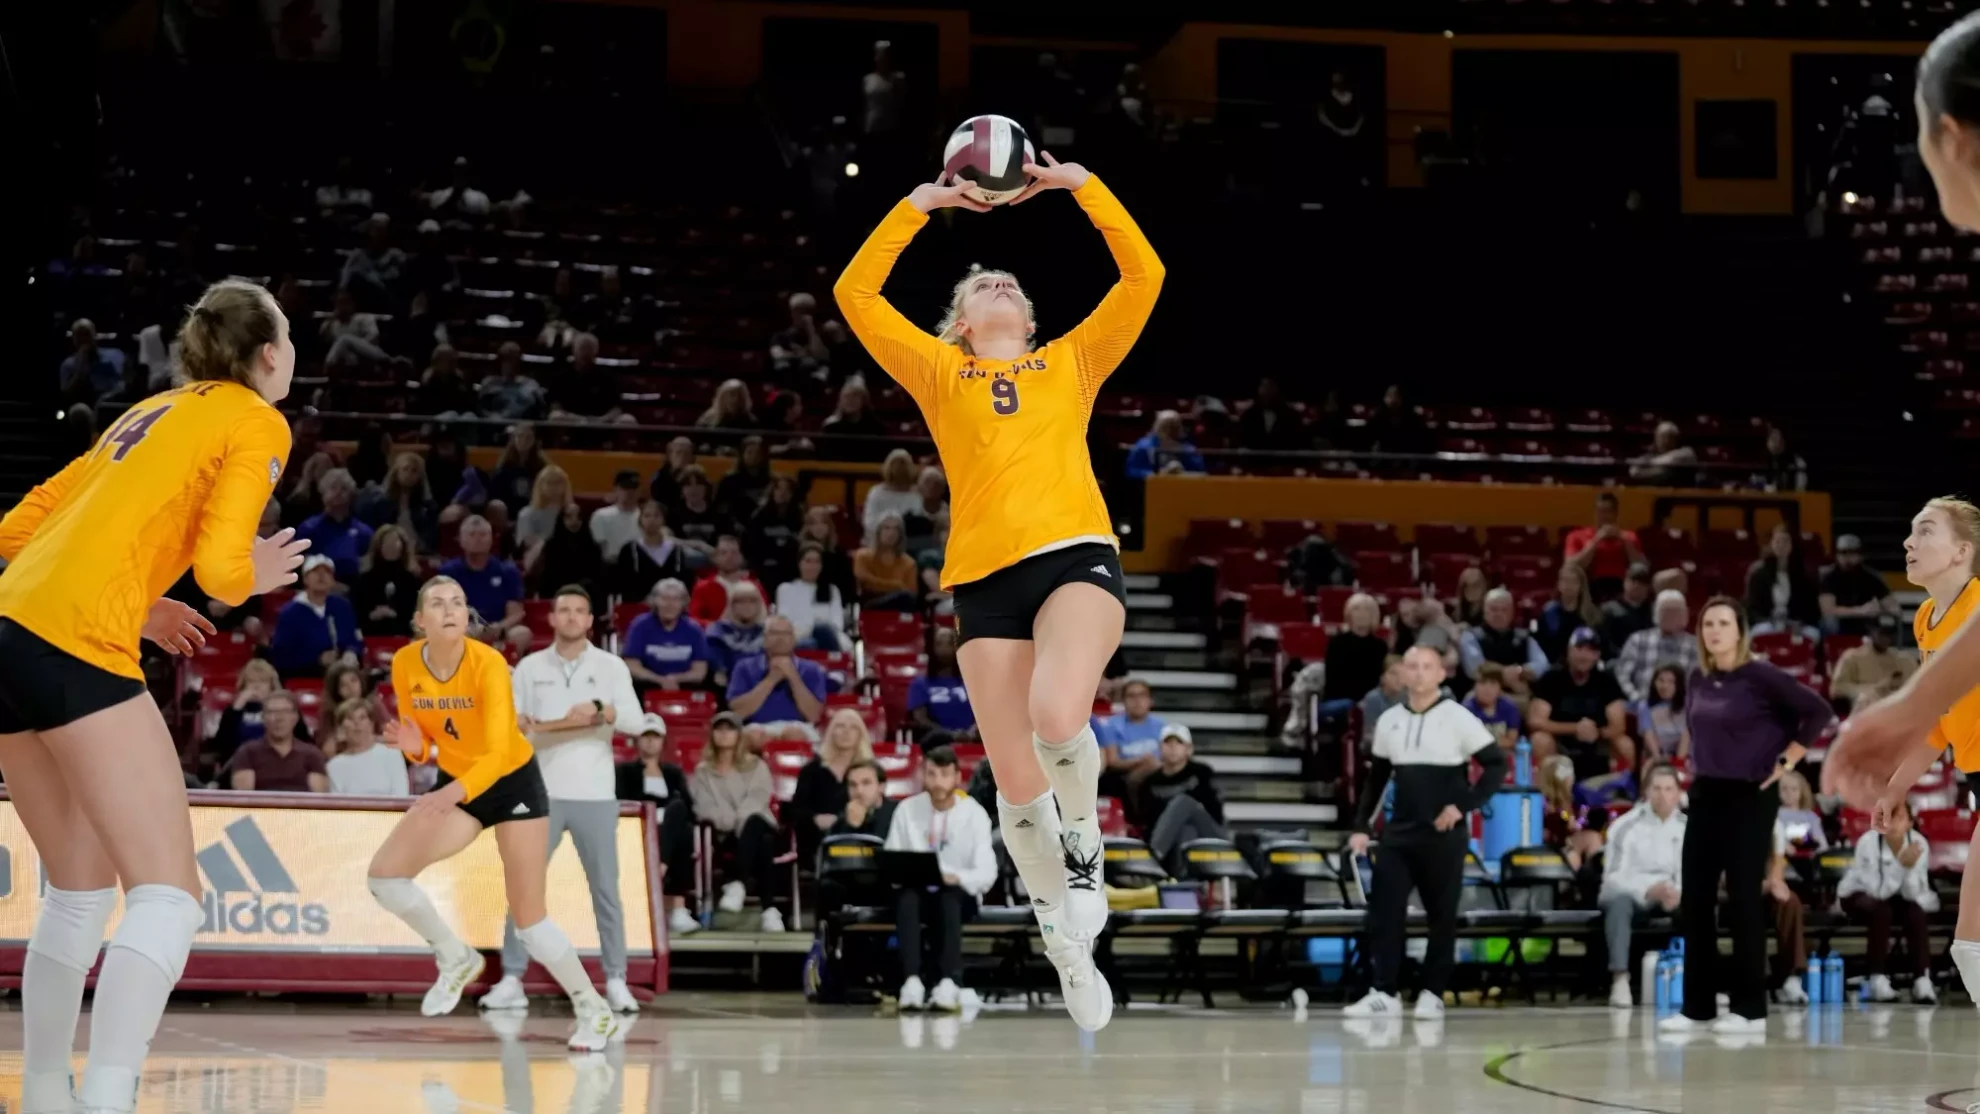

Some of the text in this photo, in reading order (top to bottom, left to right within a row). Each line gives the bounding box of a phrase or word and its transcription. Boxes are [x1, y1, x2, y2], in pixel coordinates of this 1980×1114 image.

[991, 378, 1019, 416] 9
[93, 403, 174, 463] 14
[412, 695, 476, 710] SUN DEVILS
[444, 716, 460, 740] 4
[196, 888, 331, 936] didas
